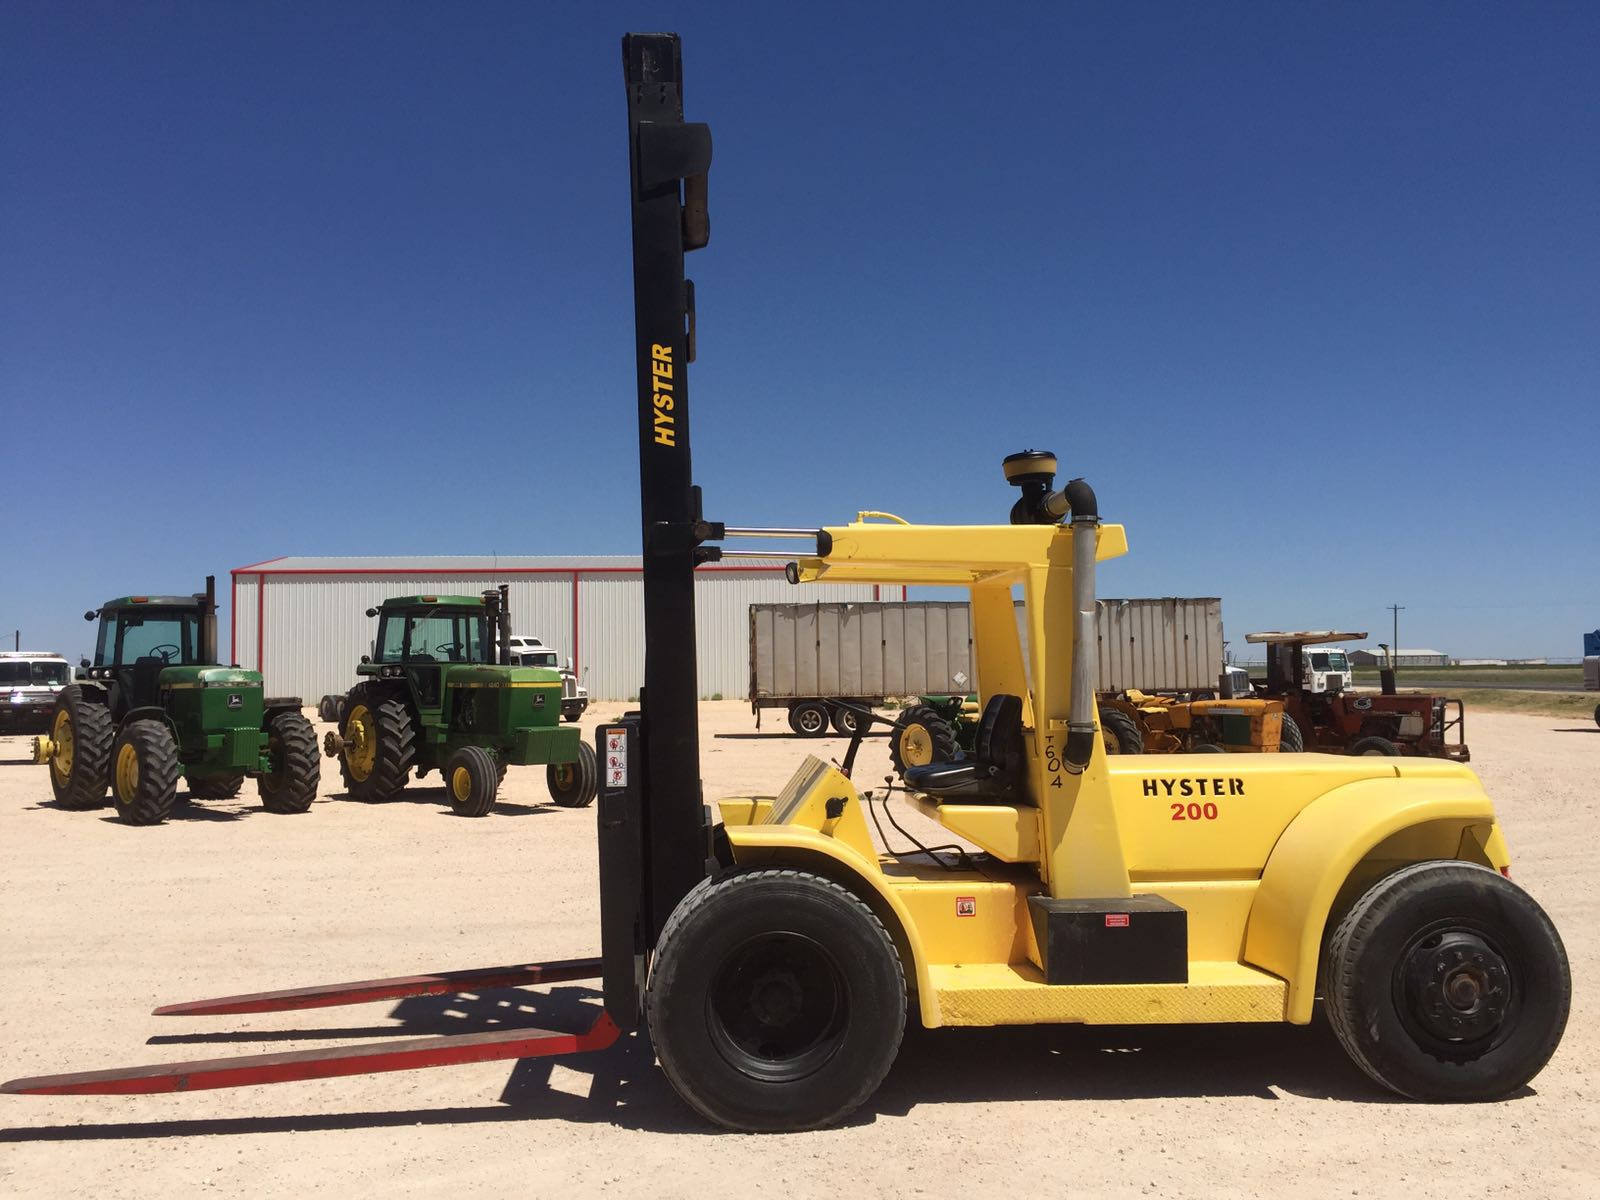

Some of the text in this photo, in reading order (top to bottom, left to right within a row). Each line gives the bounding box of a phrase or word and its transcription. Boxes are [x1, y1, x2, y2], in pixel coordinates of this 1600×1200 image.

[652, 343, 676, 447] HYSTER
[1142, 778, 1245, 796] HYSTER
[1170, 802, 1218, 821] 200
